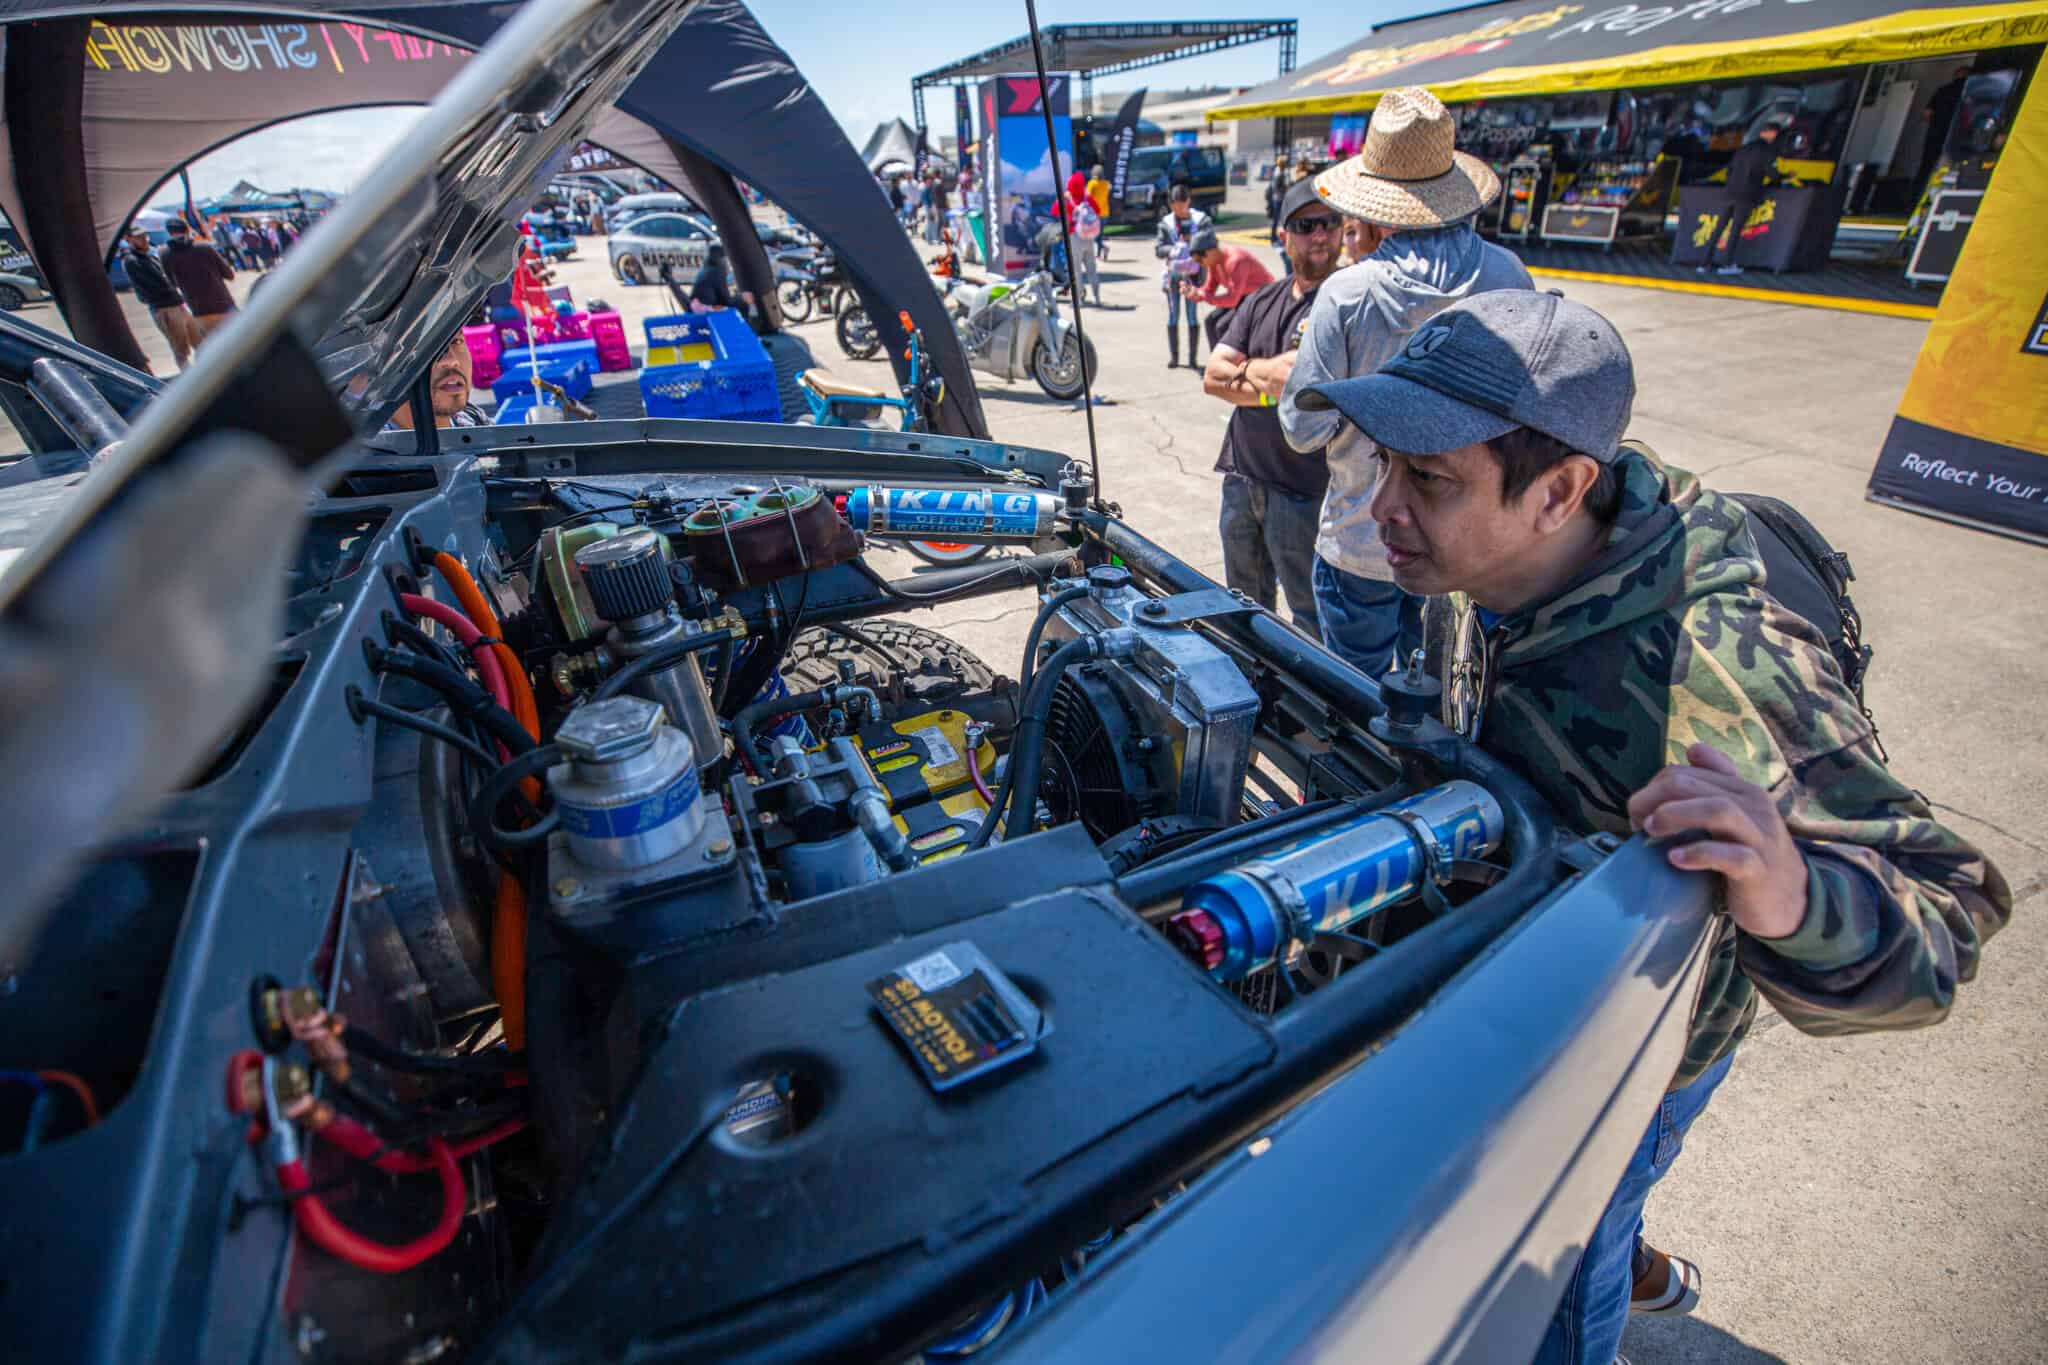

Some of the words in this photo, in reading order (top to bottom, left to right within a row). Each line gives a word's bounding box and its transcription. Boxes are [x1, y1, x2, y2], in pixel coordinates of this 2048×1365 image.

[897, 490, 1031, 513] KING
[1901, 452, 1979, 486] Reflect
[1985, 474, 2042, 500] Your
[1318, 817, 1484, 931] KIG
[912, 1000, 975, 1062] FOLLOW
